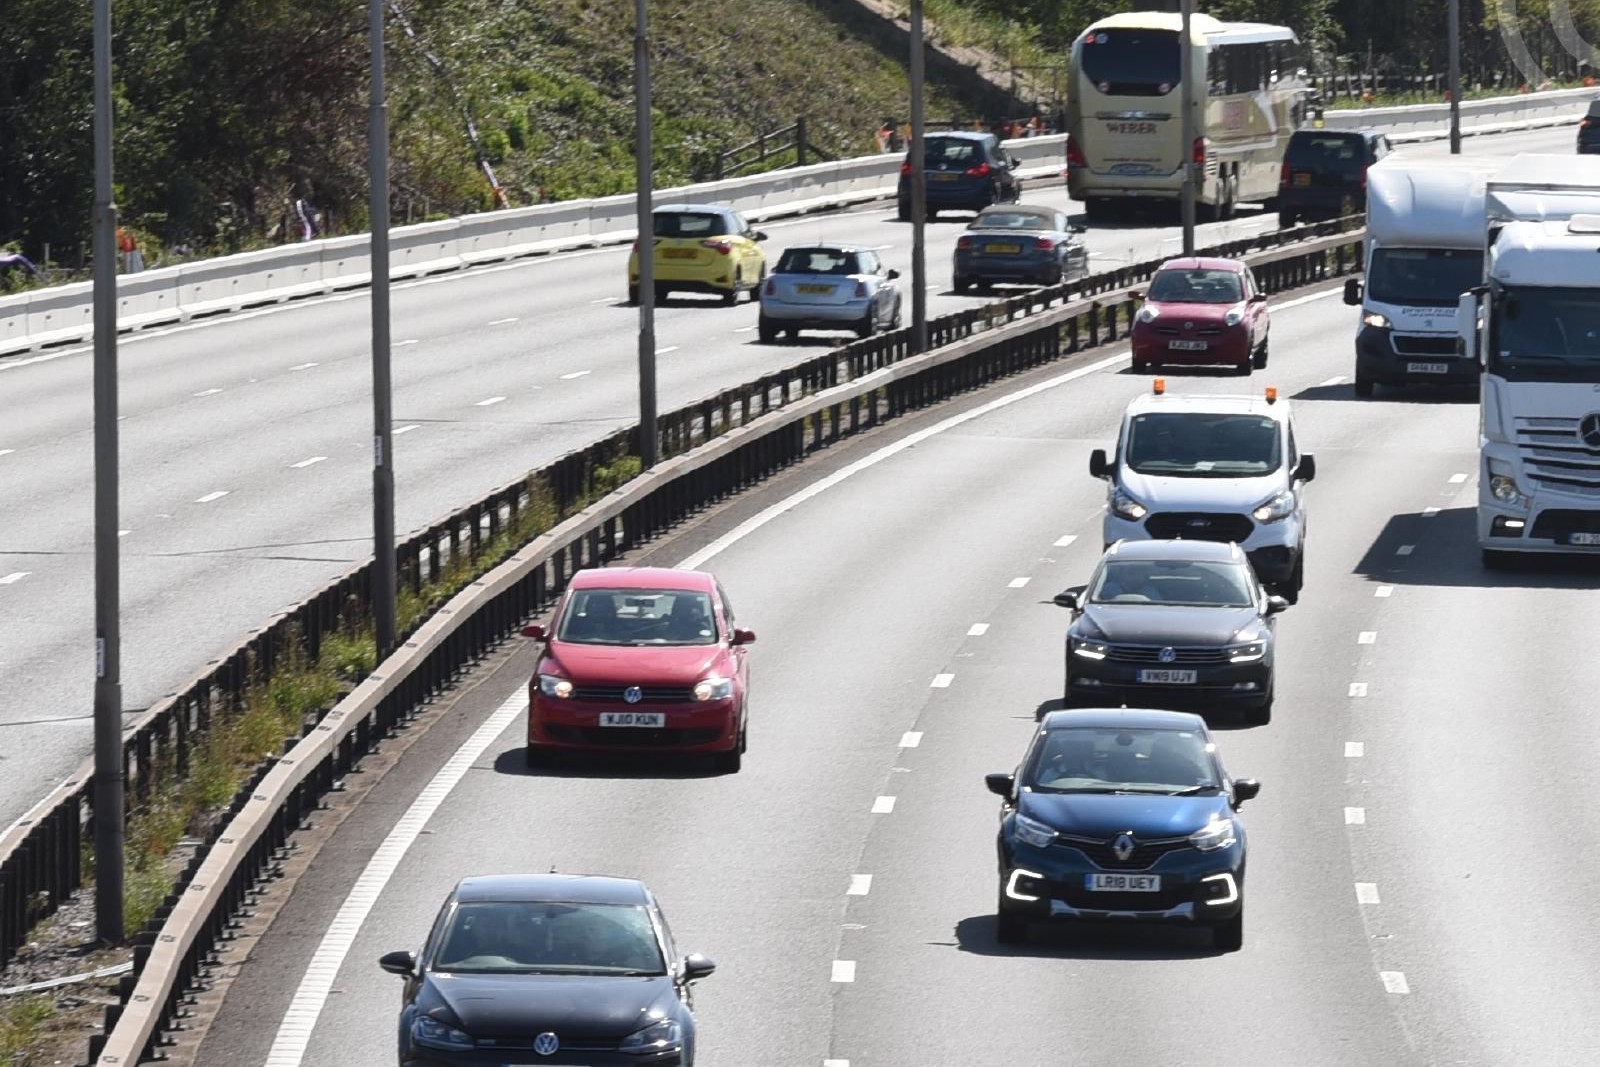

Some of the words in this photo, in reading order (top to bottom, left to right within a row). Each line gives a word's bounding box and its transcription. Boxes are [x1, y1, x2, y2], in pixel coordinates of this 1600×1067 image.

[1106, 122, 1157, 134] WEBER
[1096, 876, 1126, 889] LR18
[1128, 877, 1156, 889] UEY
